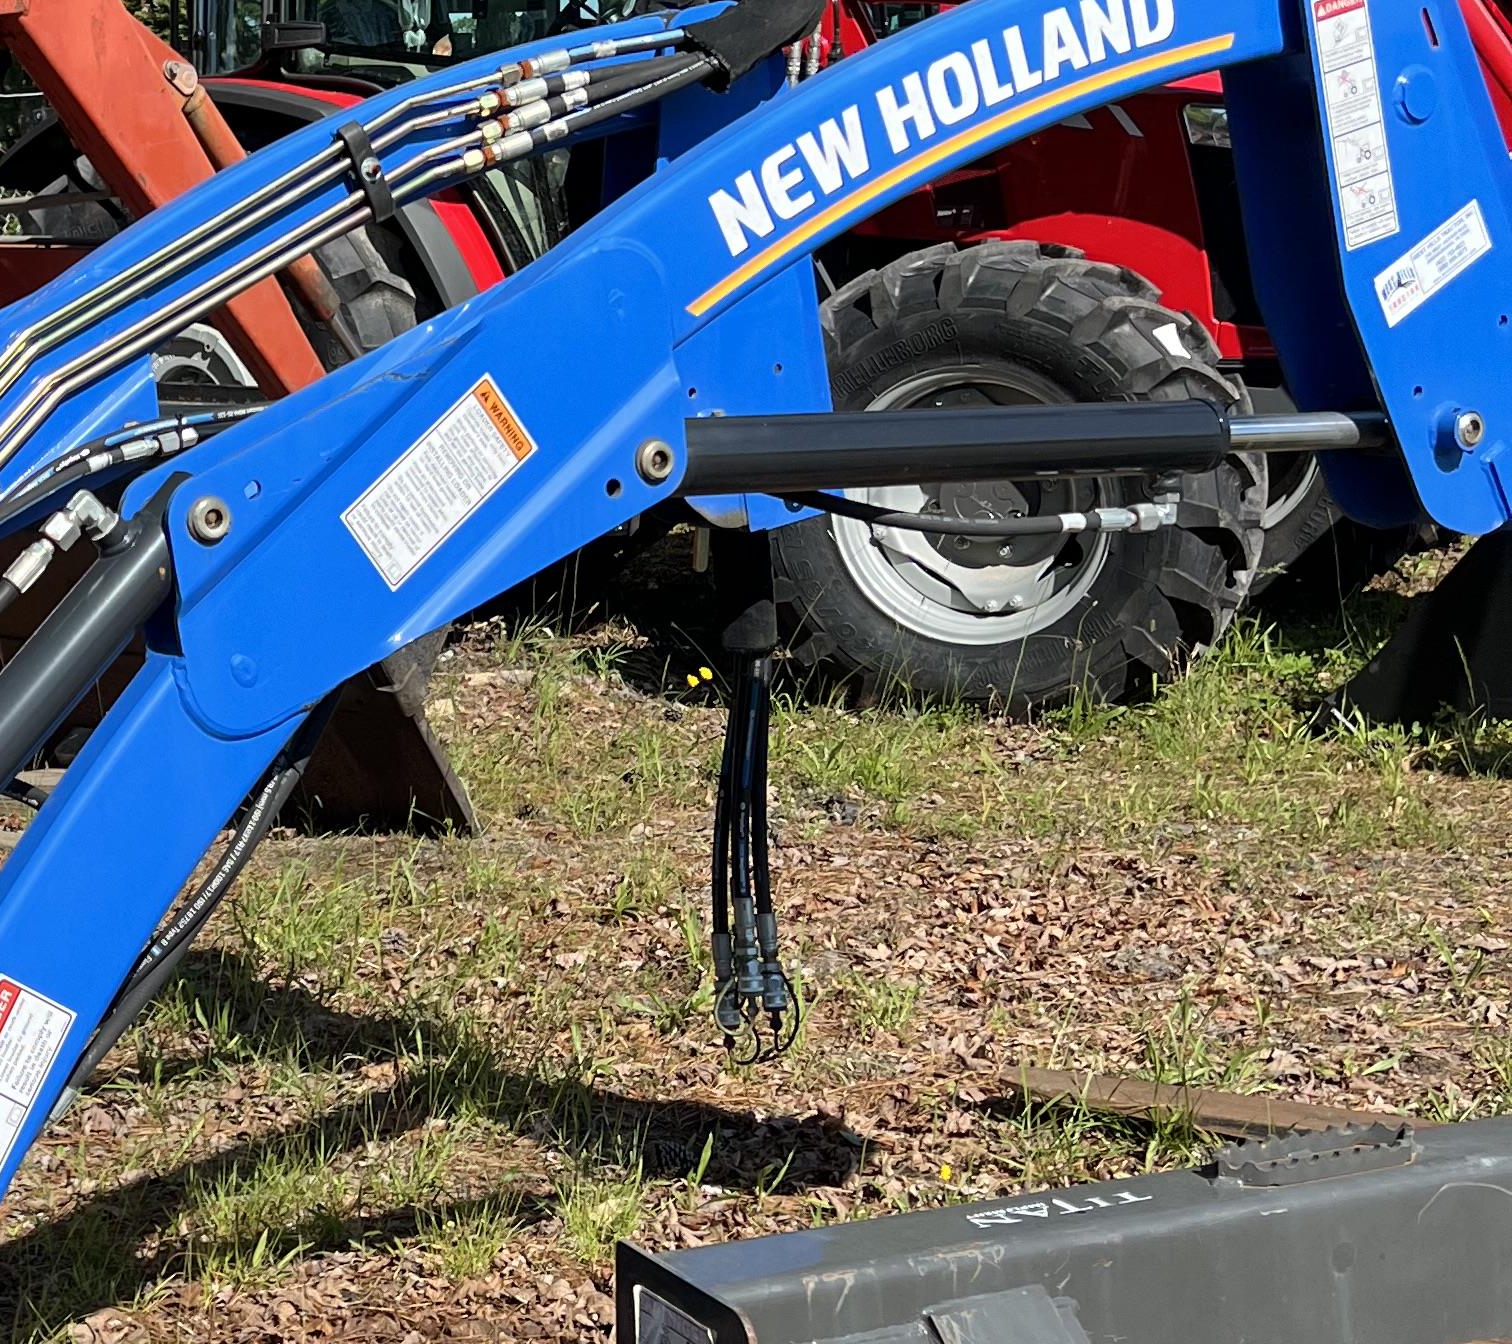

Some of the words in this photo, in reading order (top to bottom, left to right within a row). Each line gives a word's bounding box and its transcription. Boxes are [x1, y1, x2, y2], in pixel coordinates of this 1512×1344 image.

[708, 103, 871, 258] NEW
[487, 400, 525, 453] WARNING
[965, 1190, 1153, 1230] TITAN
